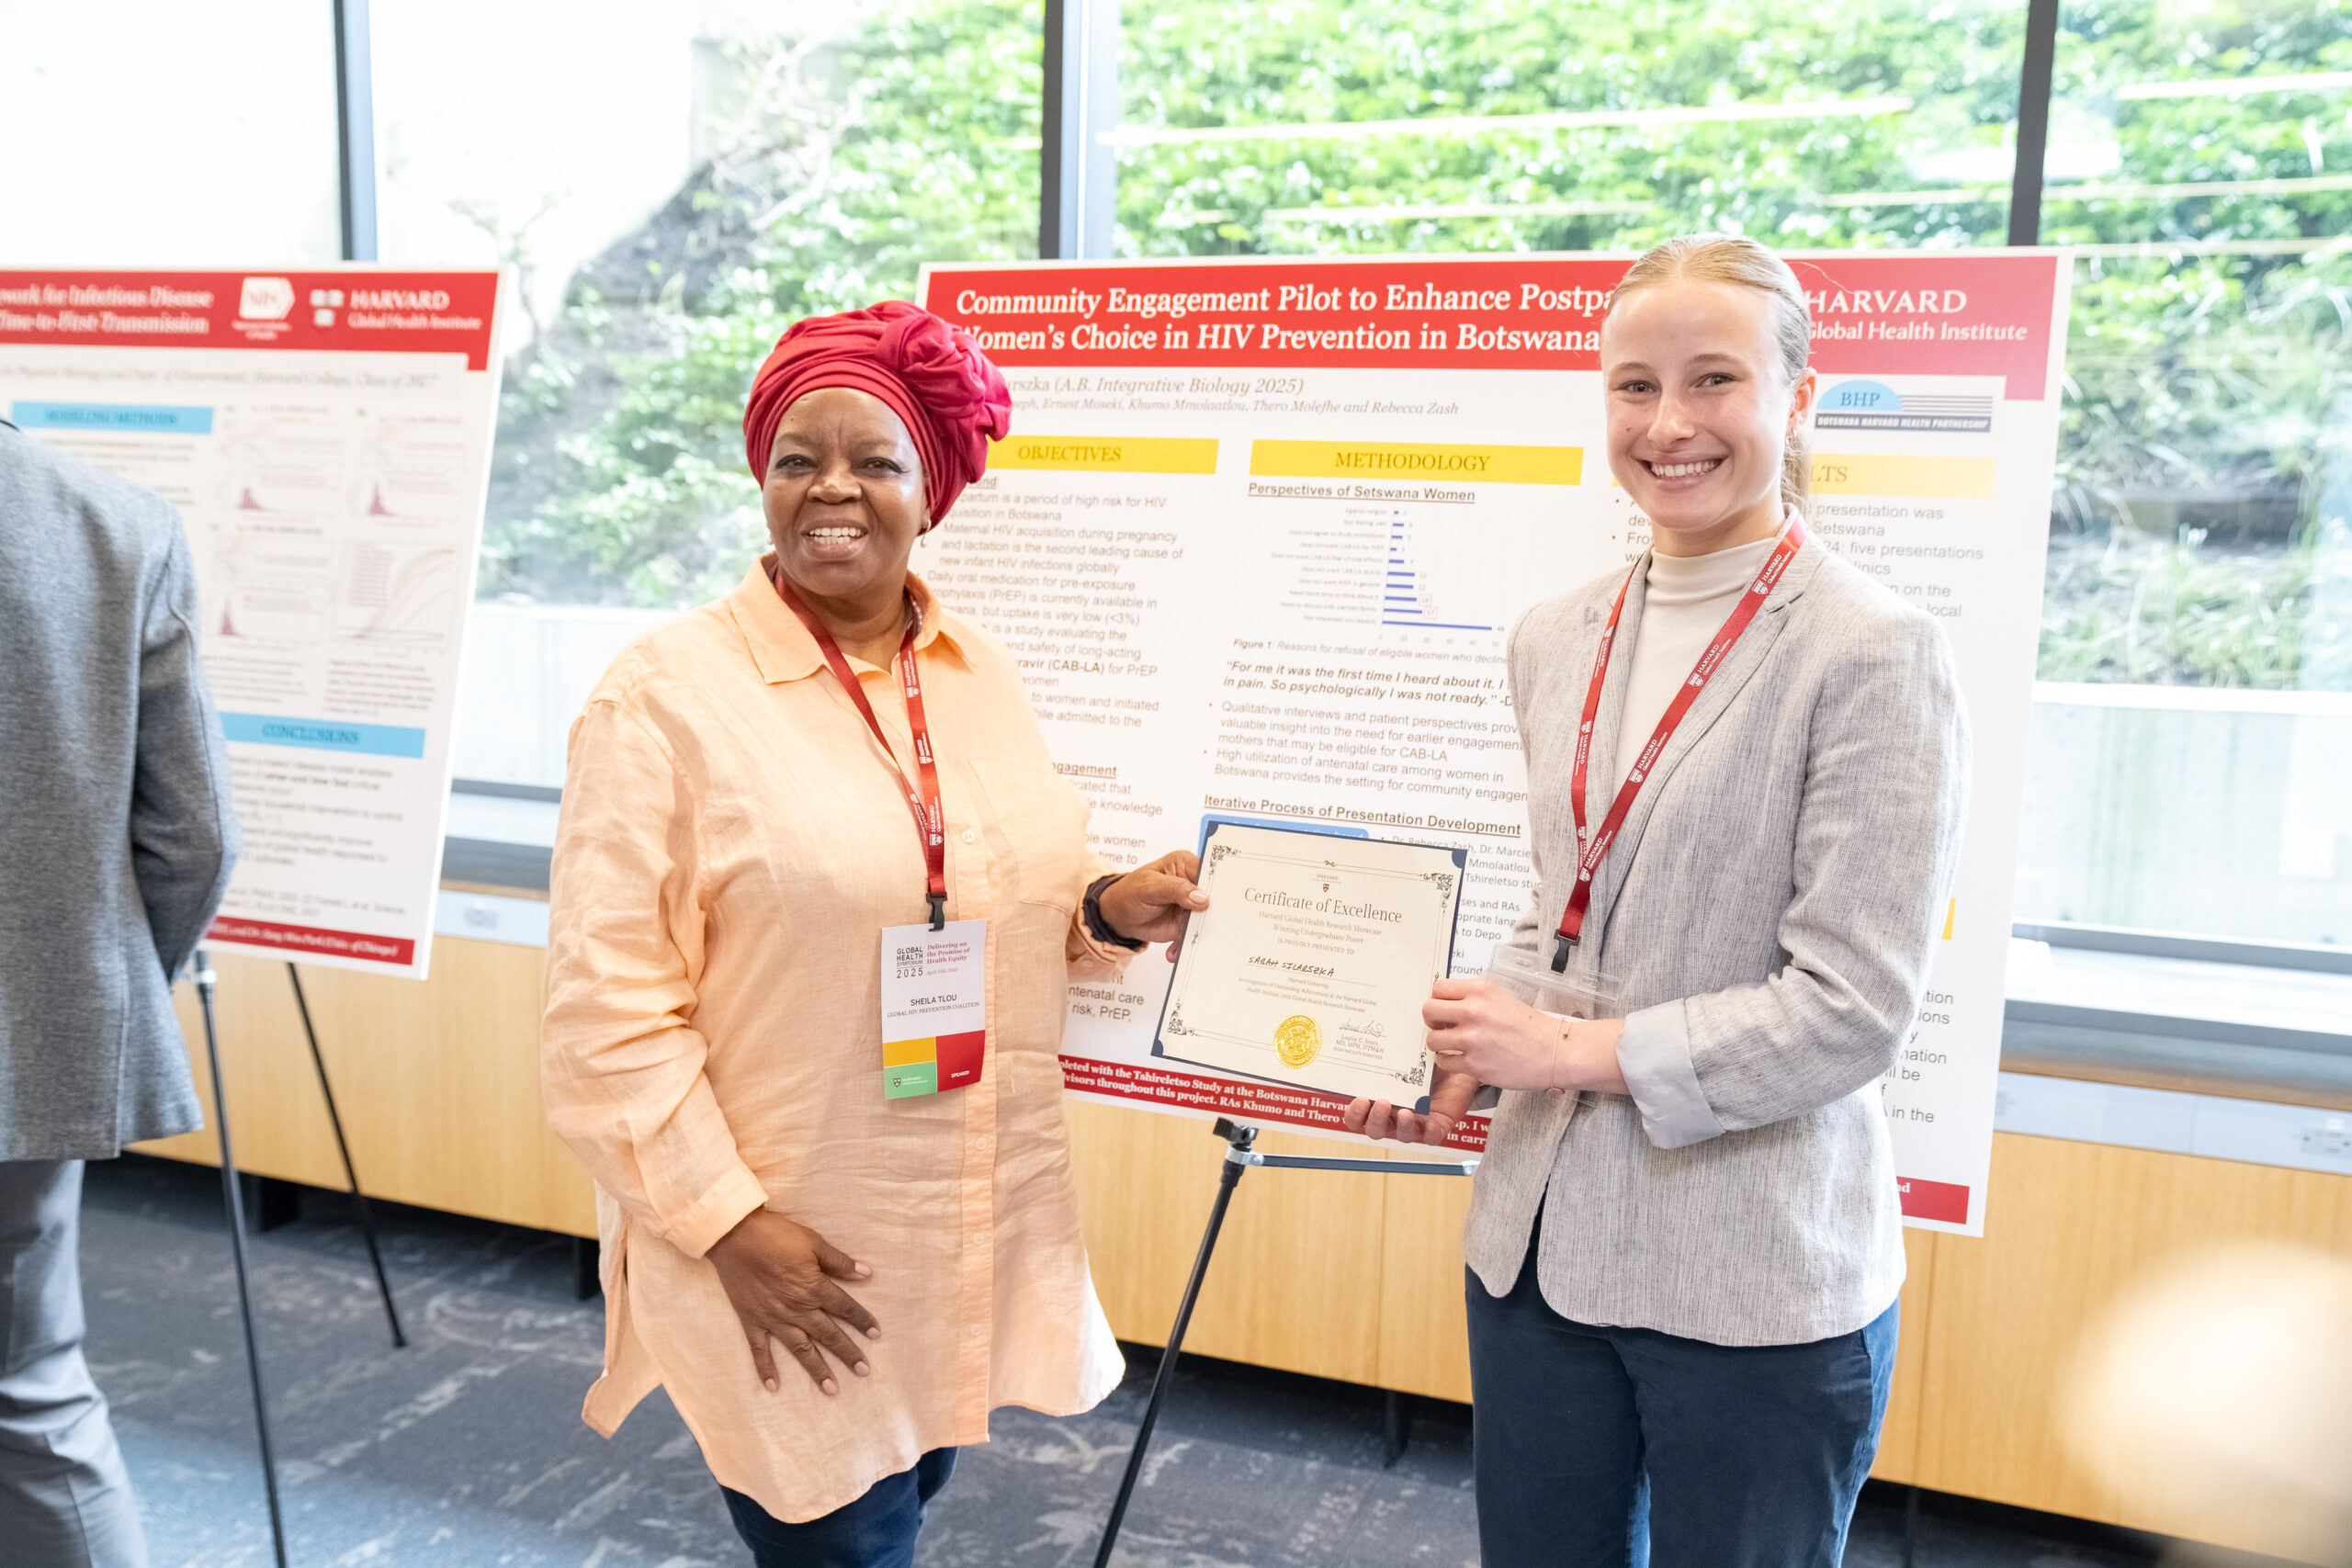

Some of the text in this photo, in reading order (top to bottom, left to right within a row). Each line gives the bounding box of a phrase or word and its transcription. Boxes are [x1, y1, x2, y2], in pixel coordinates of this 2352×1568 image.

[150, 285, 214, 308] Disease
[350, 289, 449, 310] HARVARD
[956, 289, 1102, 319] Community
[1107, 288, 1271, 318] Engagement
[1277, 284, 1341, 311] Pilot
[1350, 288, 1377, 310] to
[1385, 283, 1512, 310] Enhance
[1805, 289, 1968, 313] HARVARD
[1071, 324, 1158, 350] Choice
[1163, 324, 1189, 349] in
[1197, 324, 1256, 349] HIV
[1260, 322, 1410, 350] Prevention
[1419, 322, 1447, 349] in
[1456, 323, 1600, 351] Botswana
[1810, 321, 2029, 341] Global Health Institute
[1055, 376, 1305, 397] (A.B. Integrative Biology 2025)
[1043, 399, 1459, 415] Ernest Moseki, Khumo Mmolaatlou, Thero Molefhe and Rebecca Zash
[1840, 392, 1881, 408] BHP
[1818, 416, 1989, 429] BOTSWANA HARVARD HEALTH PARTNERSHIP
[1018, 446, 1123, 463] OBJECTIVES
[1334, 451, 1491, 472] METHODOLOGY
[1249, 482, 1476, 501] Perspectives of Setswana Women
[1815, 504, 1945, 520] presentation was
[944, 524, 1177, 546] Maternal HIV acquisition during pregnancy
[1814, 522, 1885, 536] Setswana
[1849, 541, 1984, 560] five presentations
[1762, 553, 1782, 581] HARVARD
[1048, 660, 1158, 676] (CAB-LA) for PrEP
[1255, 664, 1272, 673] me
[1276, 663, 1284, 675] it
[1288, 667, 1311, 677] was
[1316, 667, 1334, 678] the
[1338, 667, 1362, 680] first
[1365, 670, 1392, 682] time
[1396, 671, 1401, 682] I
[1404, 673, 1441, 685] heard
[1443, 676, 1480, 688] about
[1483, 678, 1494, 689] it.
[1498, 679, 1503, 690] I
[1224, 676, 1234, 686] in
[1238, 678, 1266, 690] pain.
[1271, 680, 1286, 690] So
[1289, 682, 1386, 700] psychologically
[1390, 688, 1395, 698] I
[1397, 690, 1421, 700] was
[1426, 691, 1447, 703] not
[1032, 693, 1159, 711] to women and initiated
[1057, 711, 1141, 727] admitted to the
[262, 724, 359, 745] CONCLUSIONS
[1637, 739, 1658, 769] HARVARD
[1216, 749, 1504, 783] High utilization of antenatal care among women in
[1100, 799, 1163, 817] knowledge
[1204, 794, 1521, 835] Iterative Process of Presentation Development
[1103, 838, 1146, 849] women
[1468, 858, 1530, 873] Mmolaatlou
[1465, 874, 1519, 887] Tshireletso
[1245, 887, 1402, 923] Certificate of Excellence
[1259, 911, 1383, 936] Harvard Global Health Research Showcase
[897, 946, 923, 954] GLOBAL
[927, 943, 958, 952] Delivering
[938, 949, 962, 957] Promise
[948, 954, 967, 964] Equity
[1248, 955, 1279, 968] SARAH
[897, 967, 923, 979] 2025
[910, 994, 957, 1007] SHEILA TLOU
[1118, 993, 1145, 1006] care
[887, 1001, 979, 1019] GLOBAL HIV PREVENTION COALITION
[1072, 1002, 1132, 1022] risk, PrEP.
[1091, 1064, 1308, 1105] with the Tshireletso Study at the Botswana
[1097, 1077, 1340, 1123] throughout this project. RAs Khumo and Thero
